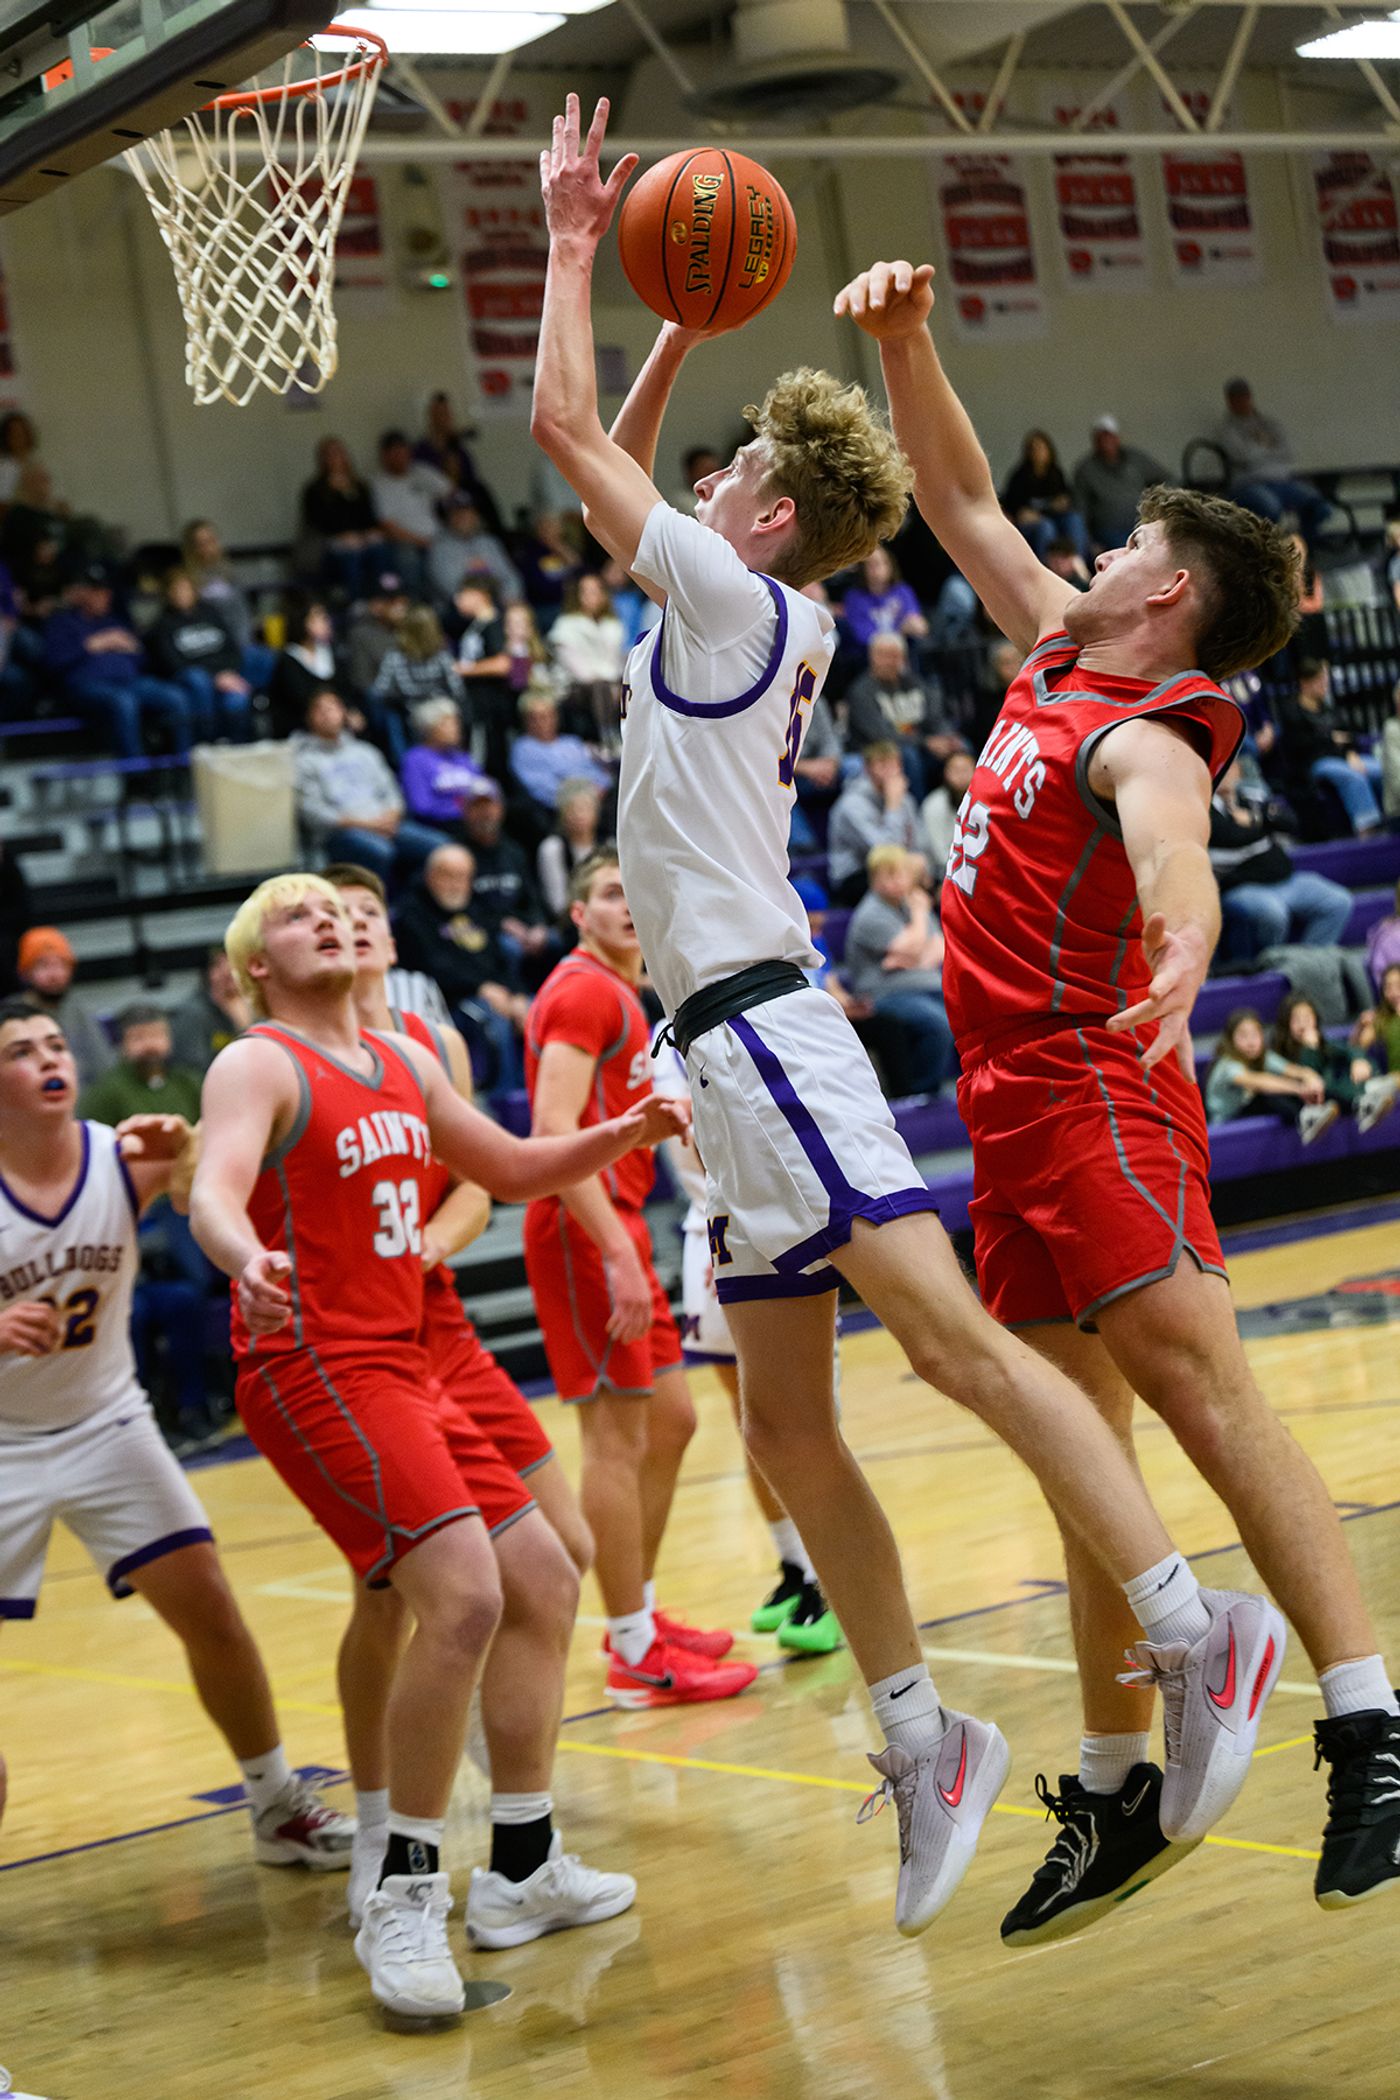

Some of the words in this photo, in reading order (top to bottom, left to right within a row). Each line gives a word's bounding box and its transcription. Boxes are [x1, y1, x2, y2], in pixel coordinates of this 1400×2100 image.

[685, 173, 724, 295] SPALDING
[738, 185, 763, 289] LEGACY
[975, 718, 1047, 820] AINTS
[371, 1178, 422, 1258] 32
